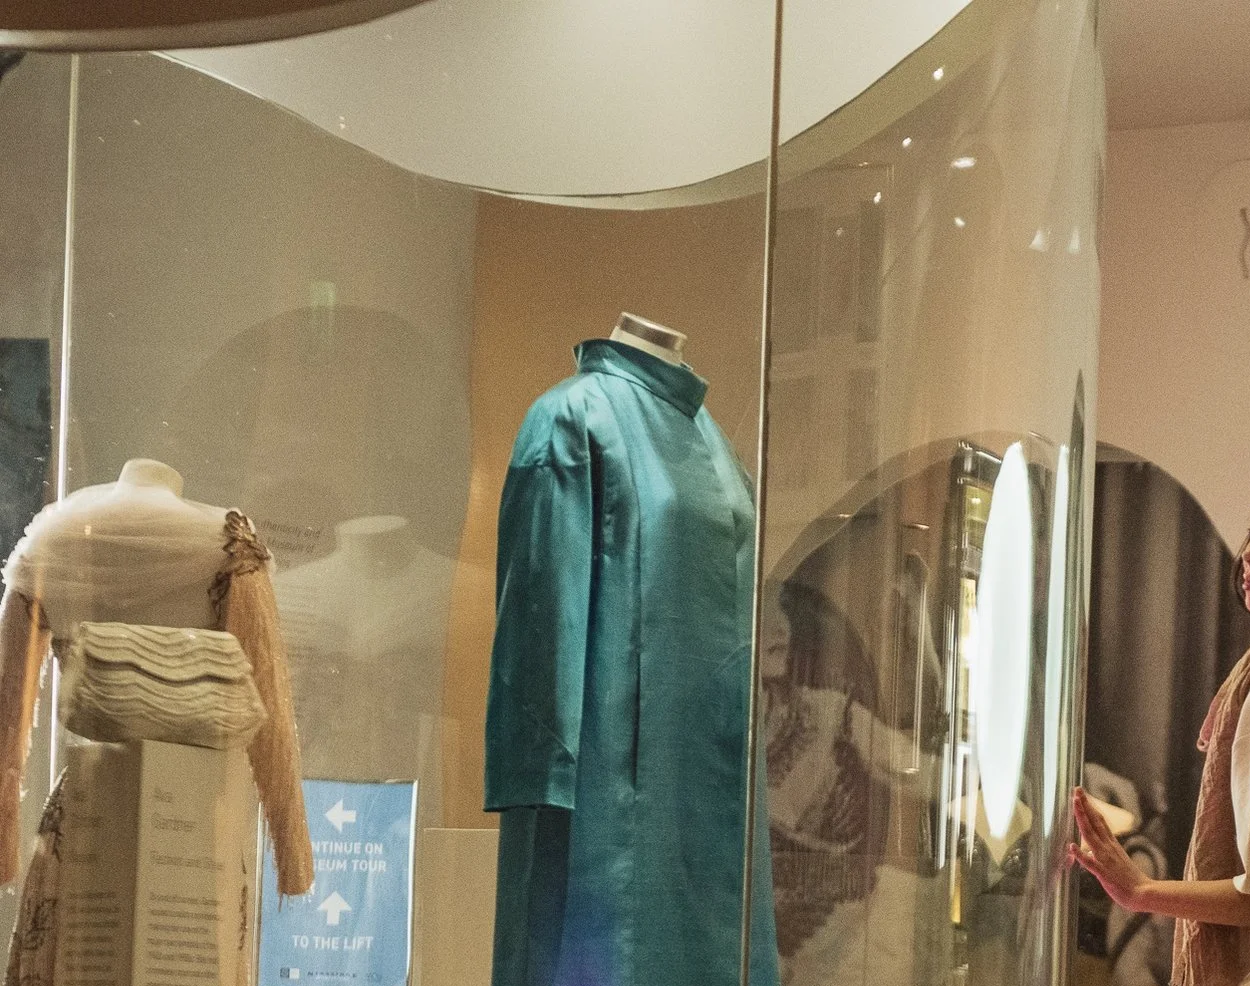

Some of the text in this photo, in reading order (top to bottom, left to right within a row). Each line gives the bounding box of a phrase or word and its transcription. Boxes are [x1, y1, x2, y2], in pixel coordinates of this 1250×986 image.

[311, 840, 384, 855] NTINUE ON
[312, 858, 387, 873] EUM TOUR
[292, 934, 374, 950] TO THE LIFT
